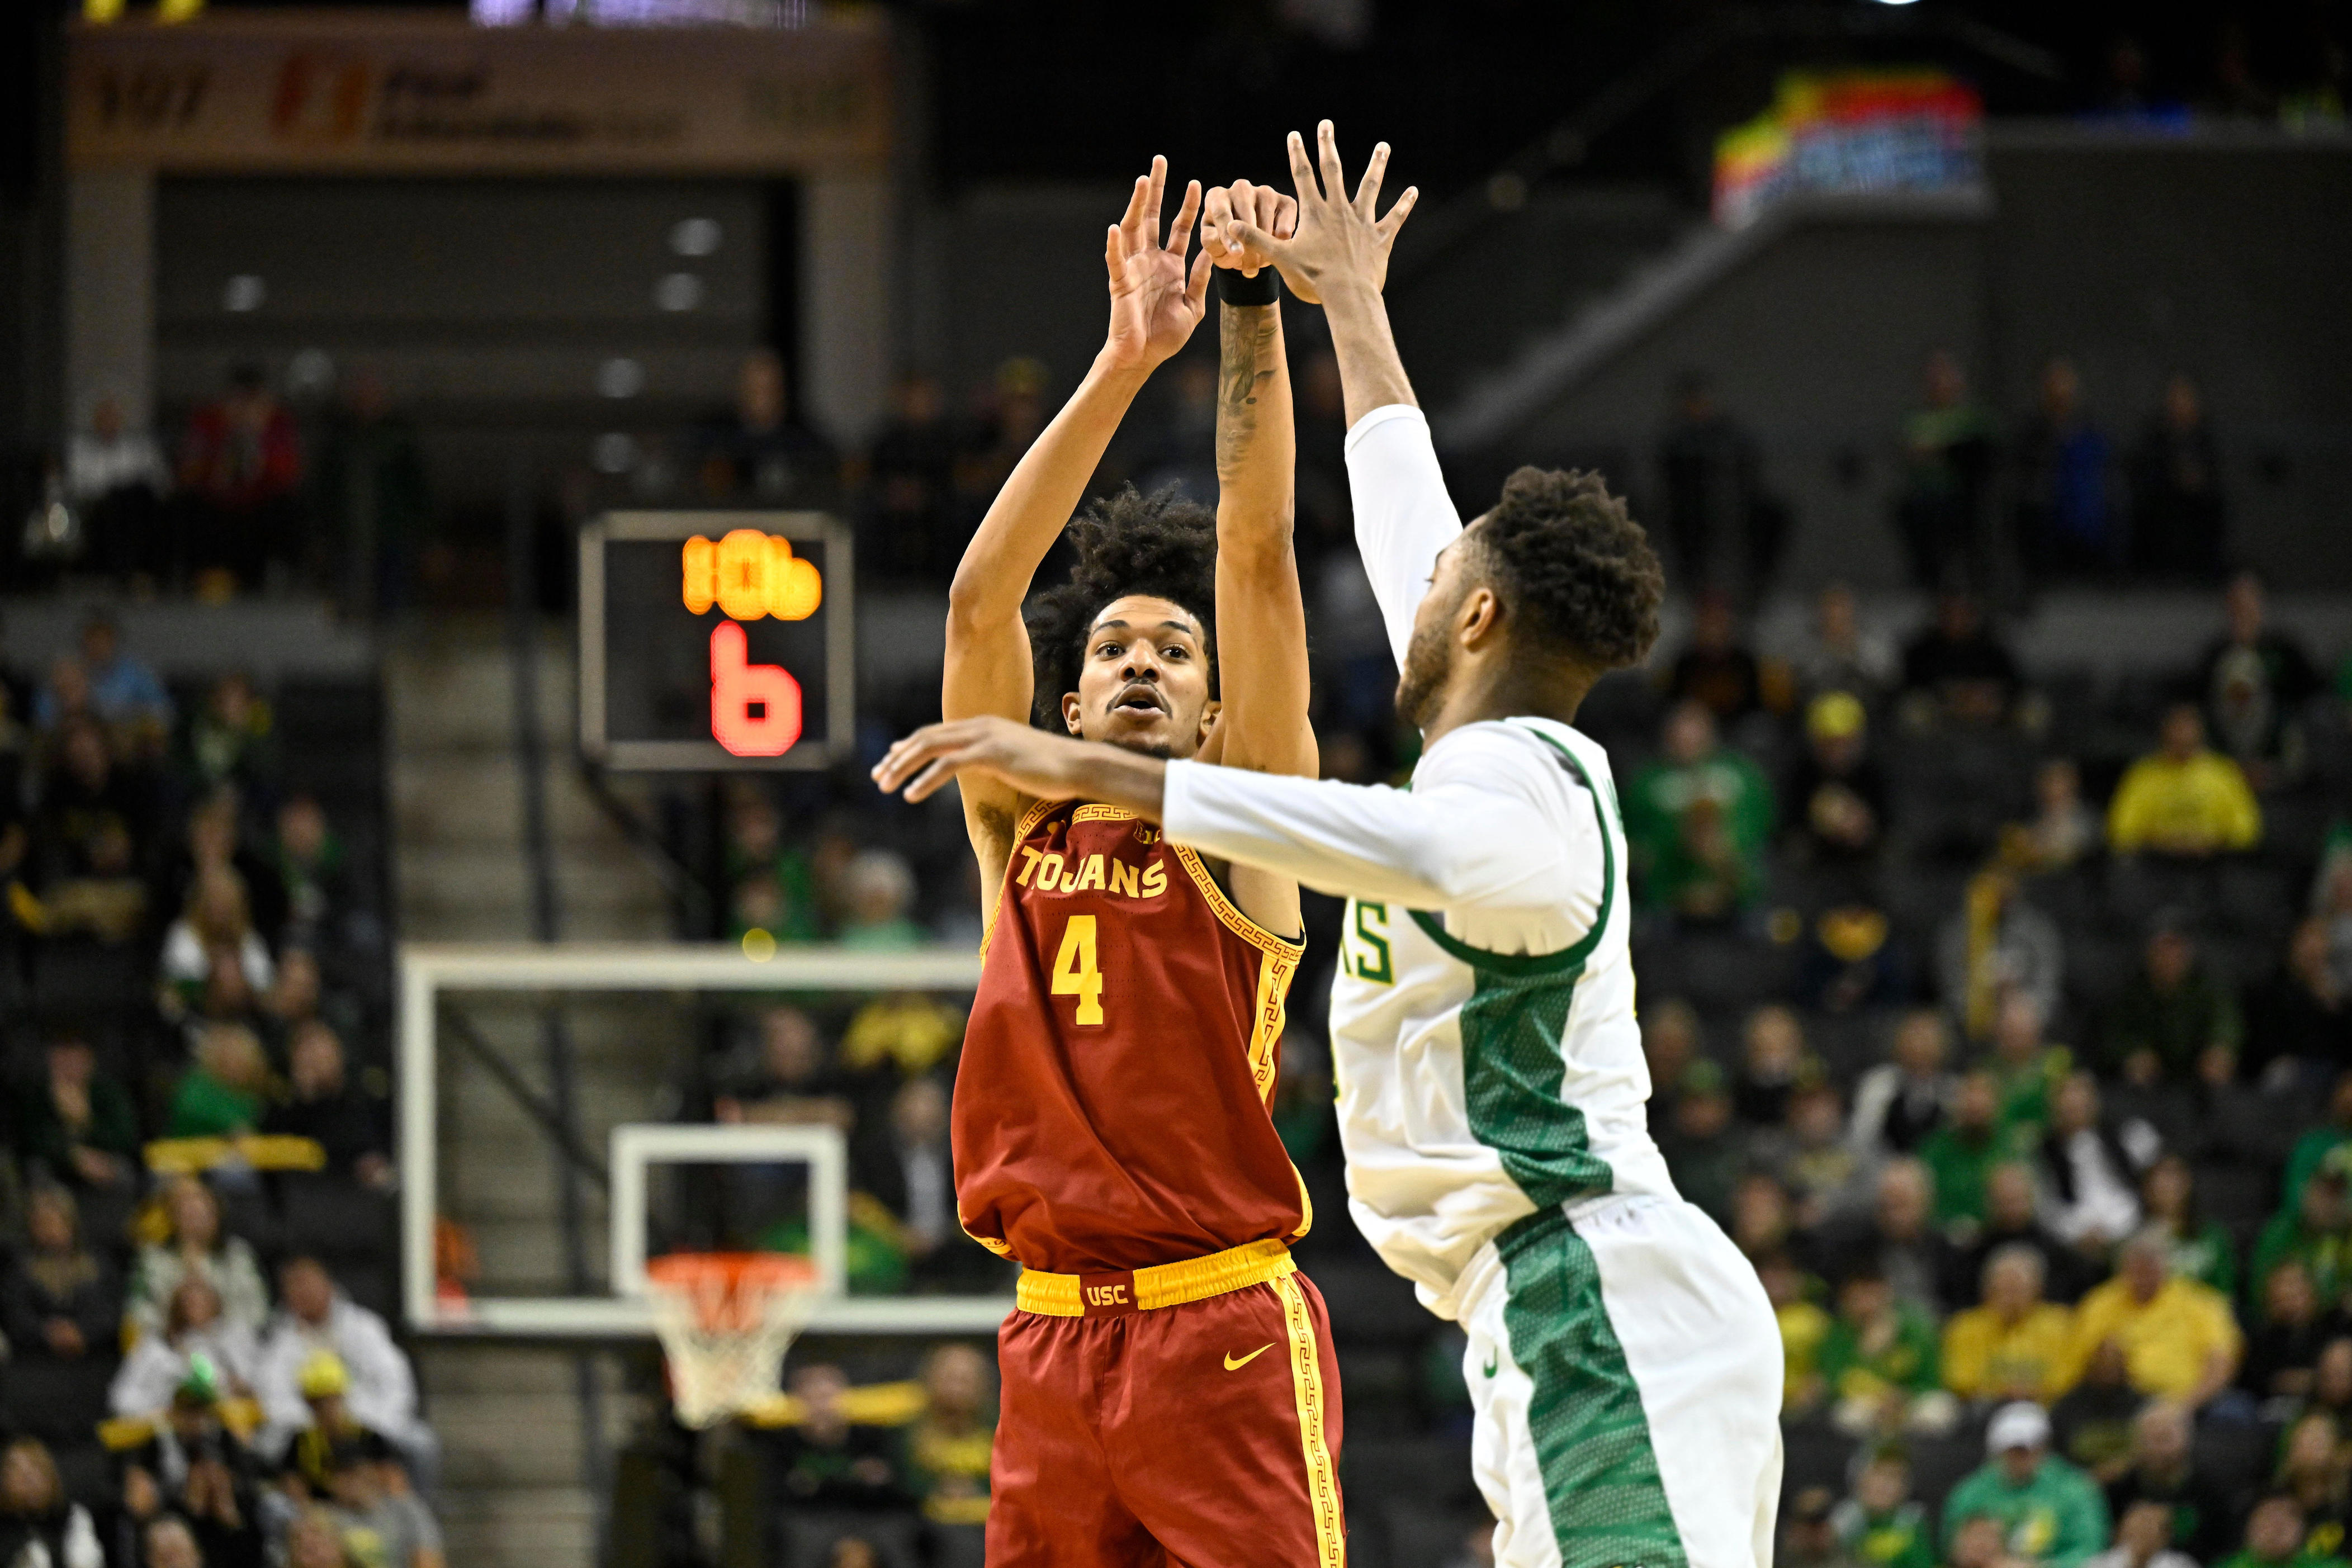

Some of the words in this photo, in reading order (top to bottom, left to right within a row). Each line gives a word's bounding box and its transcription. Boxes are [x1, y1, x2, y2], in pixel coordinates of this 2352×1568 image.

[1016, 846, 1167, 898] TOJANS
[1051, 915, 1103, 1025] 4
[1086, 1285, 1129, 1306] USC
